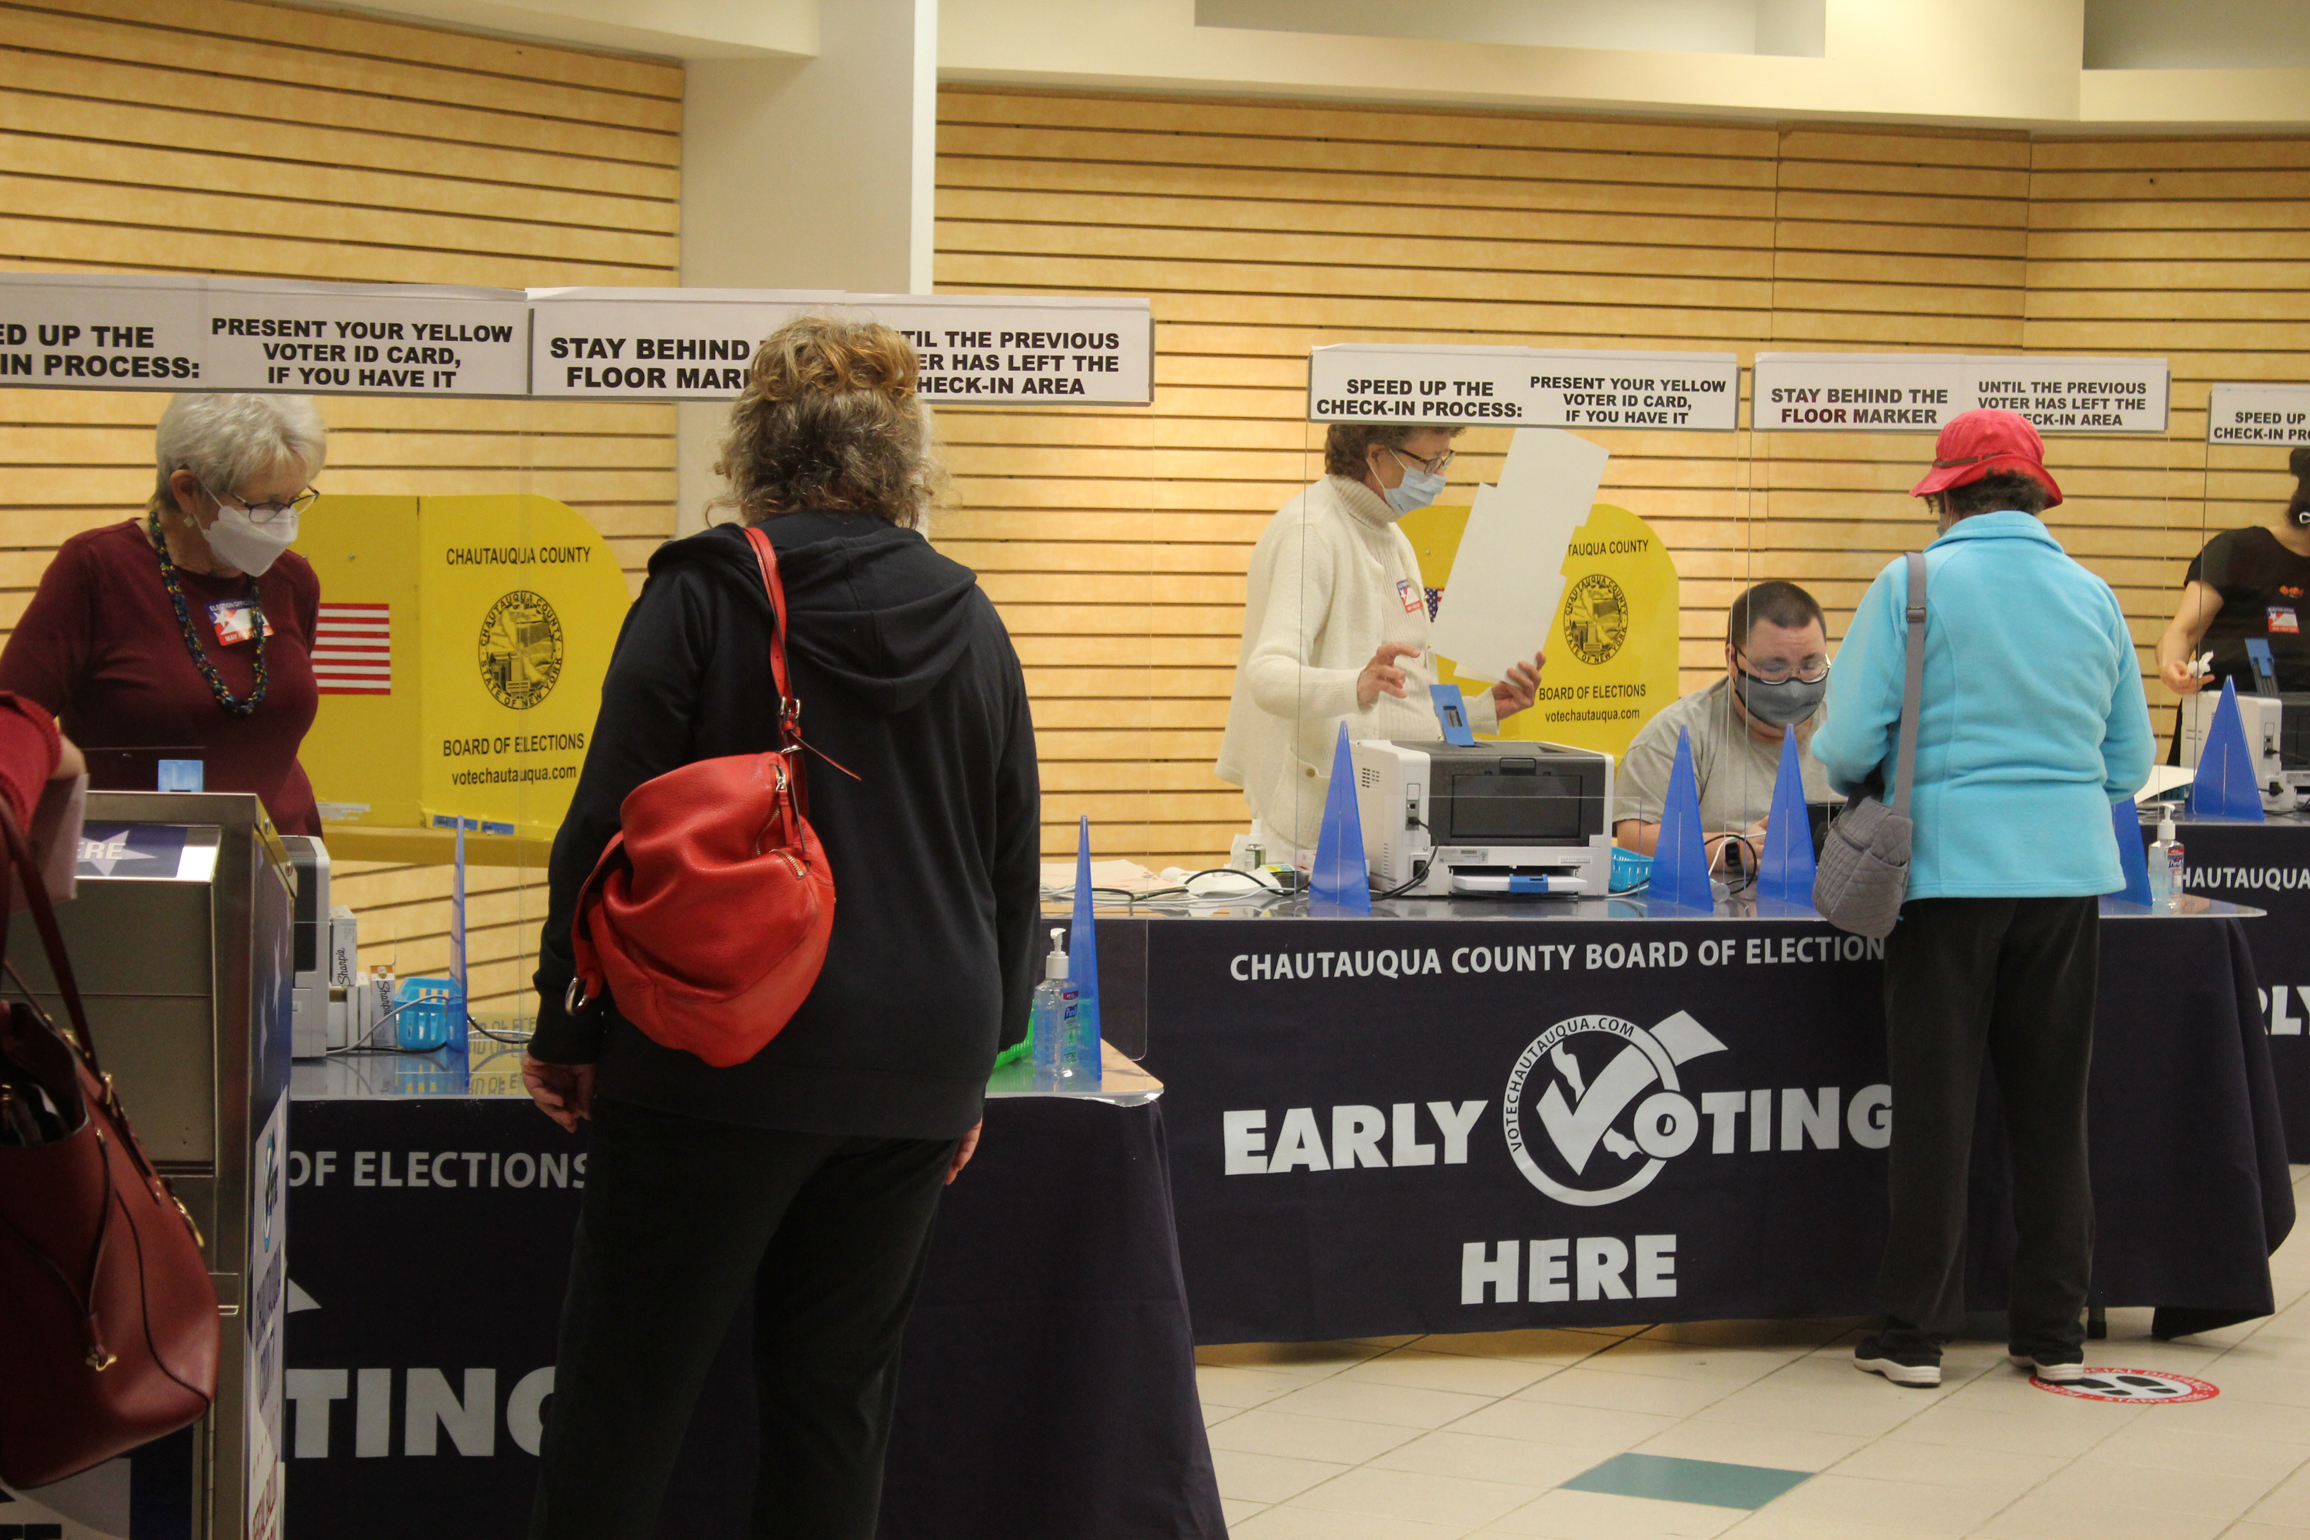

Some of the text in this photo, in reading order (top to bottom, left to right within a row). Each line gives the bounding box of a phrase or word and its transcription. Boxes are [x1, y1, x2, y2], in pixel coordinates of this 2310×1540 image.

[39, 325, 80, 346] UP
[91, 326, 153, 348] THE
[212, 318, 512, 342] PRESENT YOUR YELLOW
[896, 330, 1119, 349] TIL THE PREVIOUS
[263, 343, 460, 368] VOTER ID CARD,
[551, 338, 626, 358] STAY
[637, 339, 749, 360] BEHIND
[45, 355, 199, 378] PROCESS:
[953, 354, 999, 370] HAS
[1008, 355, 1065, 371] LEFT
[1072, 356, 1118, 372] THE
[269, 367, 456, 388] IF YOU HAVE IT
[568, 367, 750, 388] FLOOR MAR
[1022, 378, 1085, 394] AREA
[1531, 377, 1726, 392] PRESENT YOUR YELLOW
[1347, 379, 1493, 396] SPEED UP THE
[1772, 389, 1947, 403] STAY BEHIND THE
[1979, 382, 2146, 394] UNTIL THE PREVIOUS
[1317, 400, 1522, 417] CHECK-IN PROCESS:
[1563, 394, 1691, 410] VOTER ID CARD,
[1978, 398, 2145, 410] VOTER HAS LEFT THE
[1566, 410, 1688, 424] IF YOU HAVE IT
[1782, 409, 1937, 423] FLOOR MARKER
[2019, 414, 2122, 426] ECK-IN AREA
[2235, 412, 2305, 424] SPEED UP
[2214, 428, 2310, 440] CHECK-IN PR
[447, 547, 590, 565] CHAUTAUQUA COUNTY
[1609, 540, 1648, 554] COUNTY
[1609, 581, 1627, 615] COUNTY
[480, 593, 562, 647] CHAUTAUQUA COUNTY
[481, 657, 562, 708] STATE OF NEW YORK
[1539, 684, 1645, 700] BOARD OF ELECTIONS
[1546, 710, 1639, 723] votechautauqua.com
[444, 733, 584, 756] BOARD OF ELECTIONS
[451, 765, 577, 785] votechautauqua.com
[335, 947, 351, 987] Sharpie
[1231, 936, 1885, 980] CHAUTAUQUA COUNTY BOARD OF ELECTION
[1505, 1017, 1635, 1153] VOTECHAUTAUQUA.COM
[1224, 1100, 1488, 1175] EARLY
[289, 1151, 337, 1186] OF
[1461, 1235, 1676, 1304] HERE
